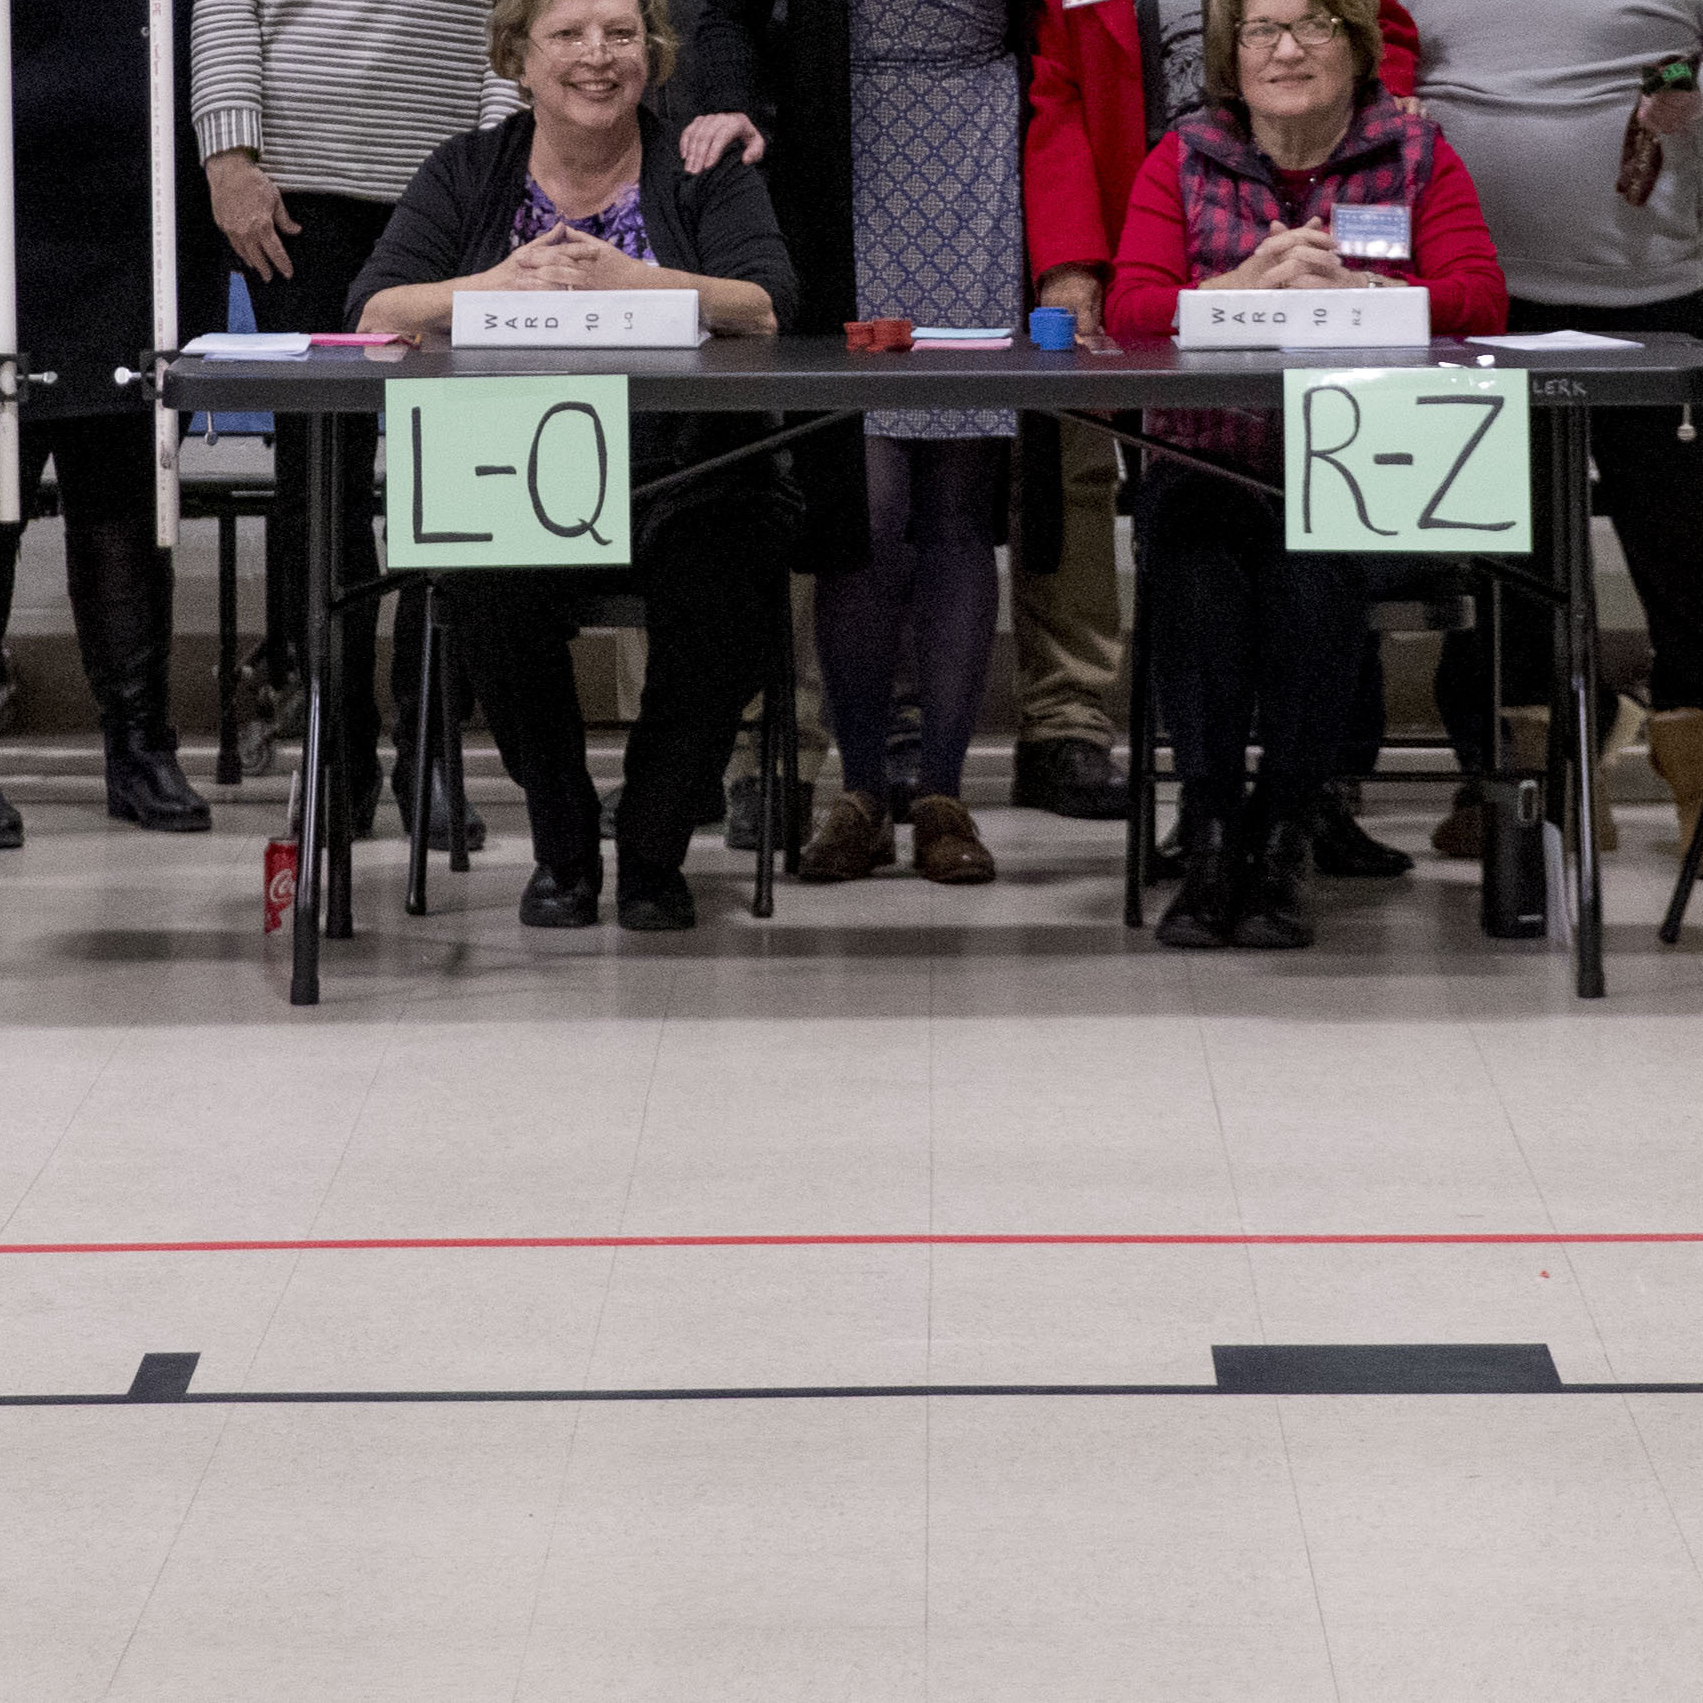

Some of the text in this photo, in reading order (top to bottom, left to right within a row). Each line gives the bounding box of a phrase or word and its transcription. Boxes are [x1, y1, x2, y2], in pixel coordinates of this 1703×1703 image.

[585, 312, 599, 331] 10
[623, 311, 633, 330] L-Q
[1313, 307, 1327, 326] 10
[1352, 307, 1362, 326] R-Z
[1532, 377, 1587, 398] LERK
[1302, 385, 1517, 537] R-Z
[412, 401, 613, 546] L-Q
